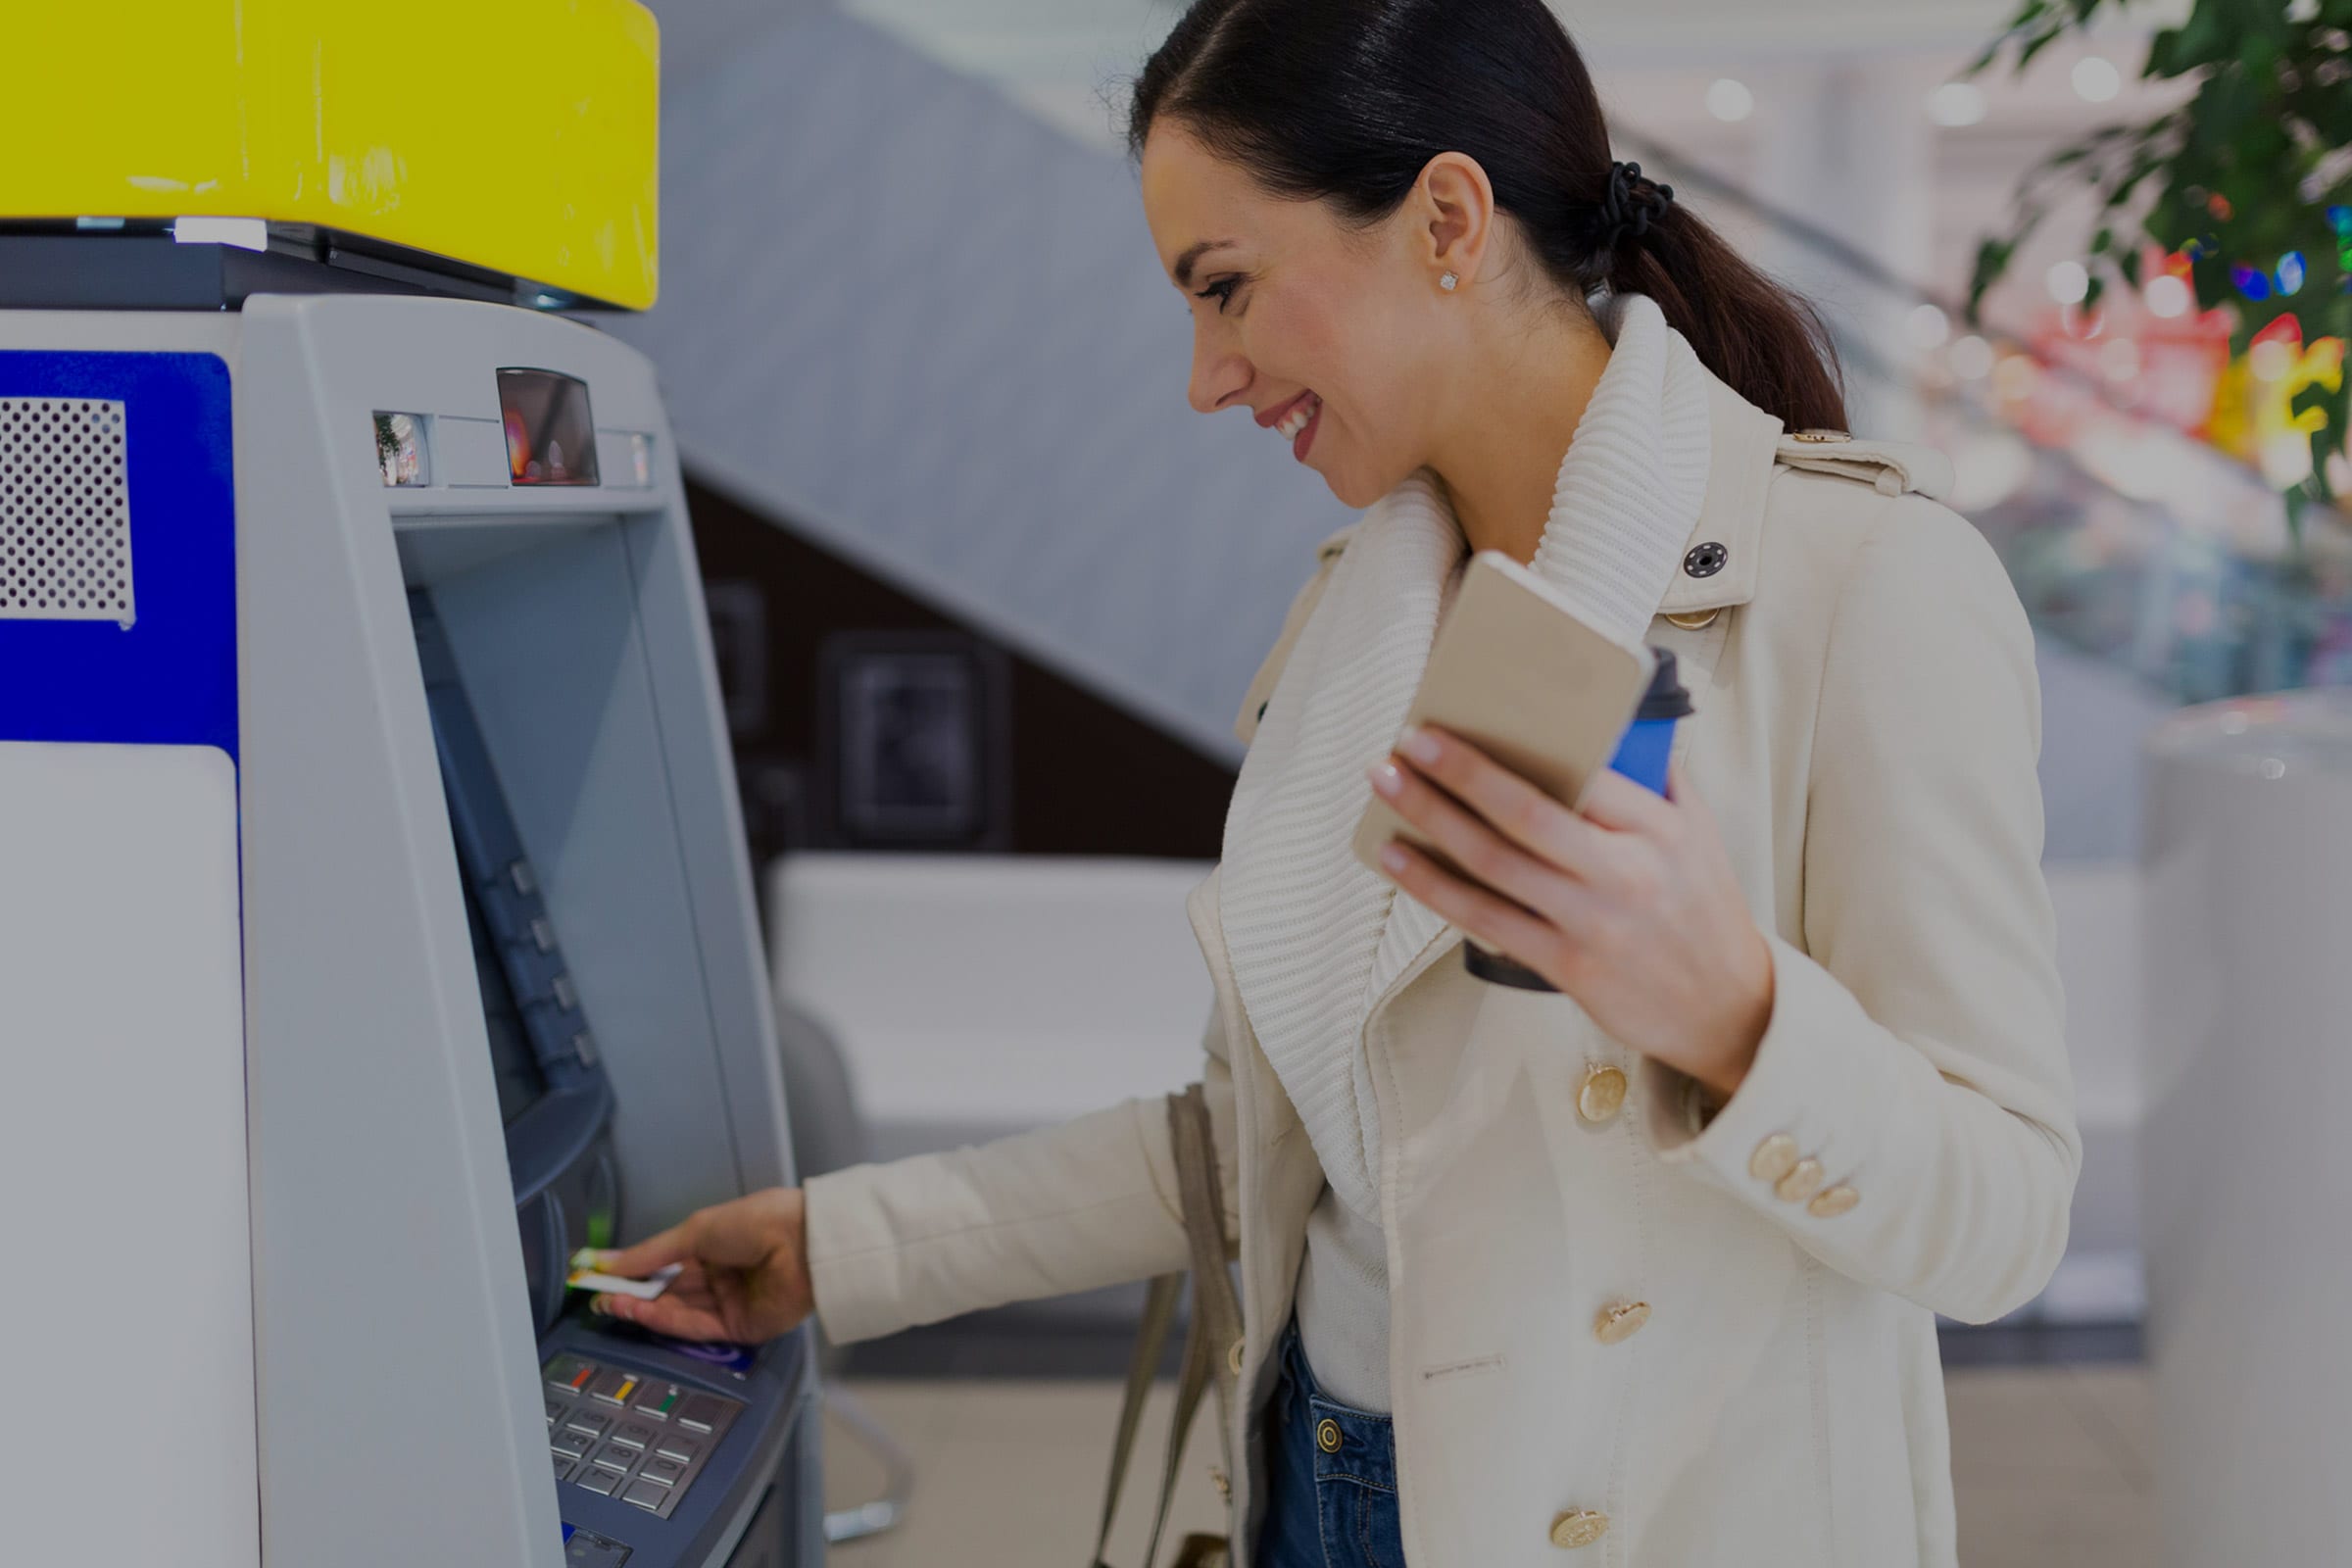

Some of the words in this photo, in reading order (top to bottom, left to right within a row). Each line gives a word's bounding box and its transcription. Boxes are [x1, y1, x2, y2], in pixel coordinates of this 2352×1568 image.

[611, 1446, 632, 1458] 8
[656, 1460, 677, 1471] 0
[592, 1469, 614, 1481] 7
